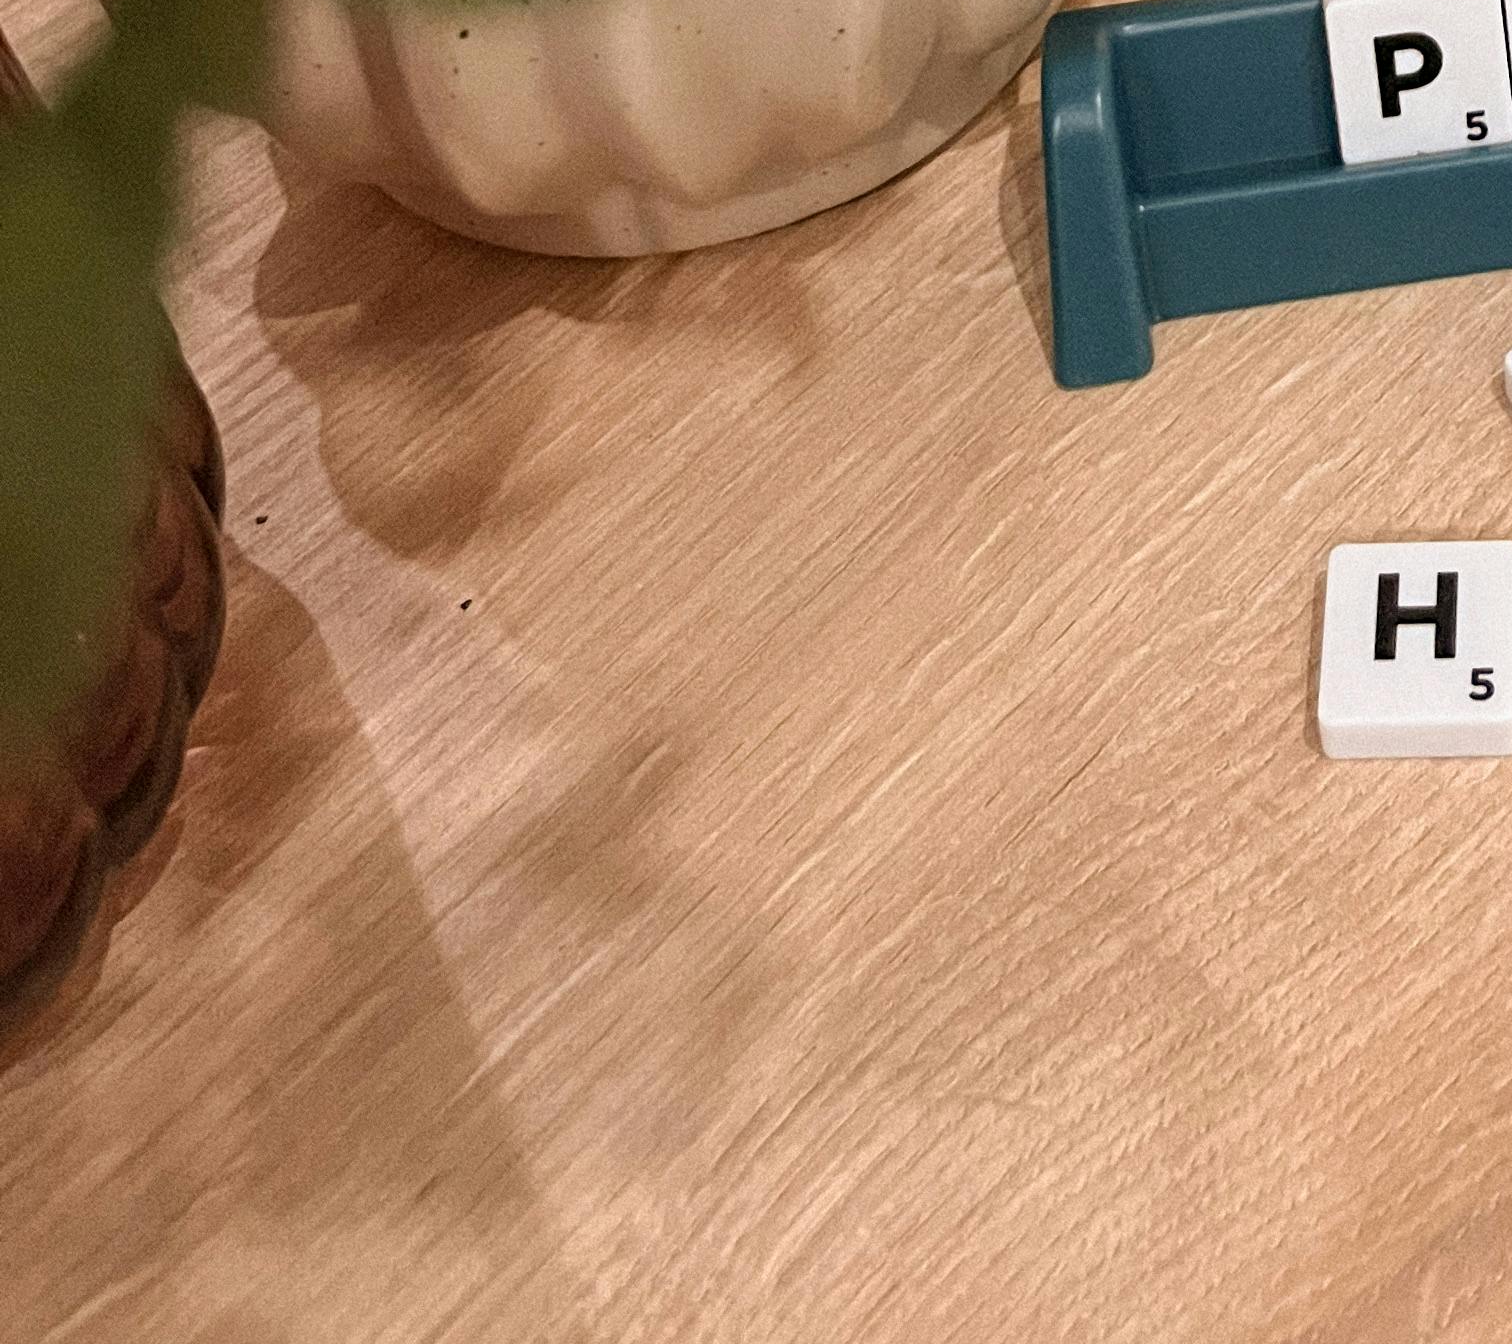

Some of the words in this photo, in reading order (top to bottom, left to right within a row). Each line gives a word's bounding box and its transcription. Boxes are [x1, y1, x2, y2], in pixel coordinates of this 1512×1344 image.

[1465, 109, 1490, 143] 5
[1372, 570, 1460, 662] H
[1467, 667, 1496, 702] 5
